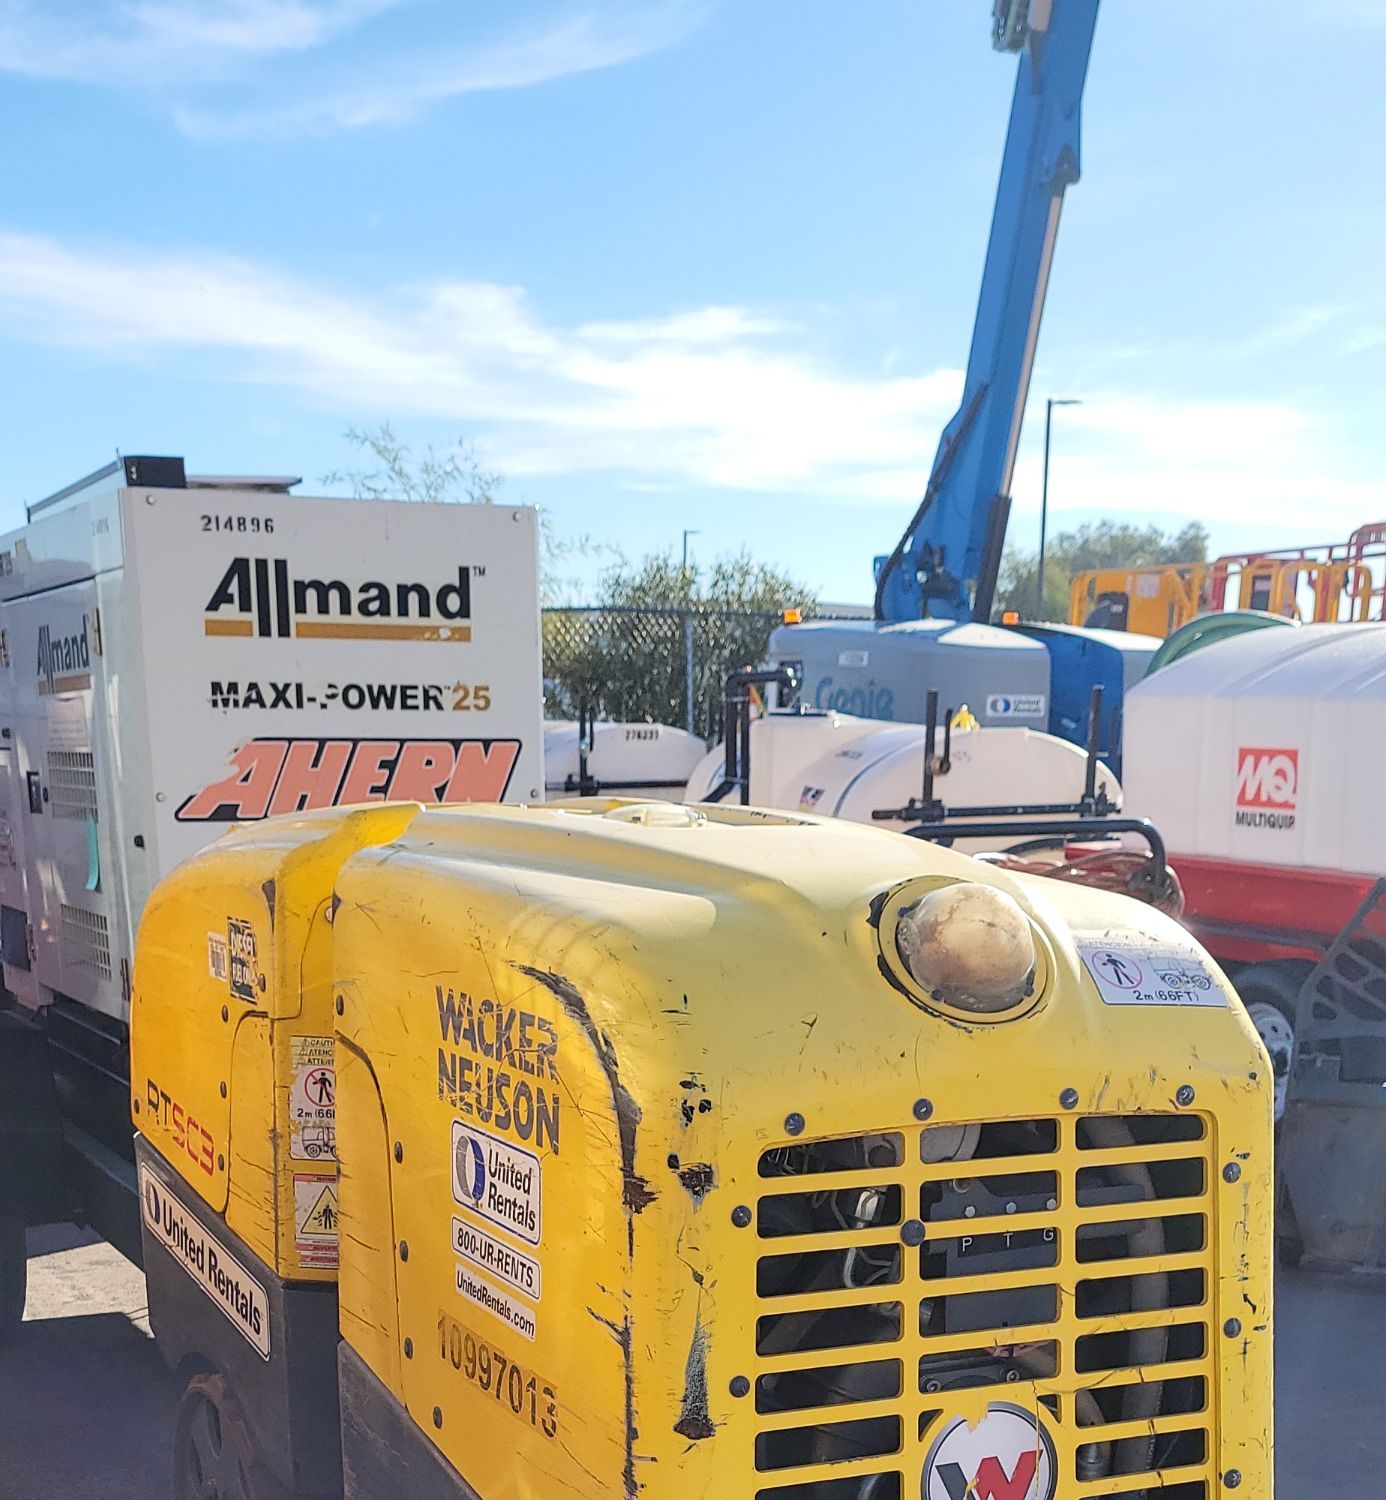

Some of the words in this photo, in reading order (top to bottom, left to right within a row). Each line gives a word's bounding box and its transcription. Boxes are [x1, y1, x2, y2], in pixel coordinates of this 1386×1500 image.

[201, 515, 274, 533] 214896
[204, 557, 471, 638] Allmand
[37, 614, 89, 693] Allmand
[452, 685, 492, 711] 25
[176, 738, 523, 821] AHERN
[1236, 752, 1297, 806] MQ
[1235, 811, 1296, 829] MULTIQUIP
[309, 1048, 334, 1057] ATENC
[436, 984, 559, 1085] WACKER
[314, 1108, 336, 1119] (66
[437, 1047, 560, 1156] NEUSON
[488, 1143, 532, 1196] United
[488, 1182, 536, 1231] Rentals
[163, 1199, 205, 1274] United
[208, 1249, 262, 1336] Rentals
[457, 1227, 534, 1288] 800-UR-RENTS
[962, 1237, 973, 1252] P
[1003, 1232, 1014, 1248] T
[1043, 1228, 1054, 1241] G
[457, 1269, 535, 1336] UnitedRentals.com
[437, 1315, 558, 1438] 10997013
